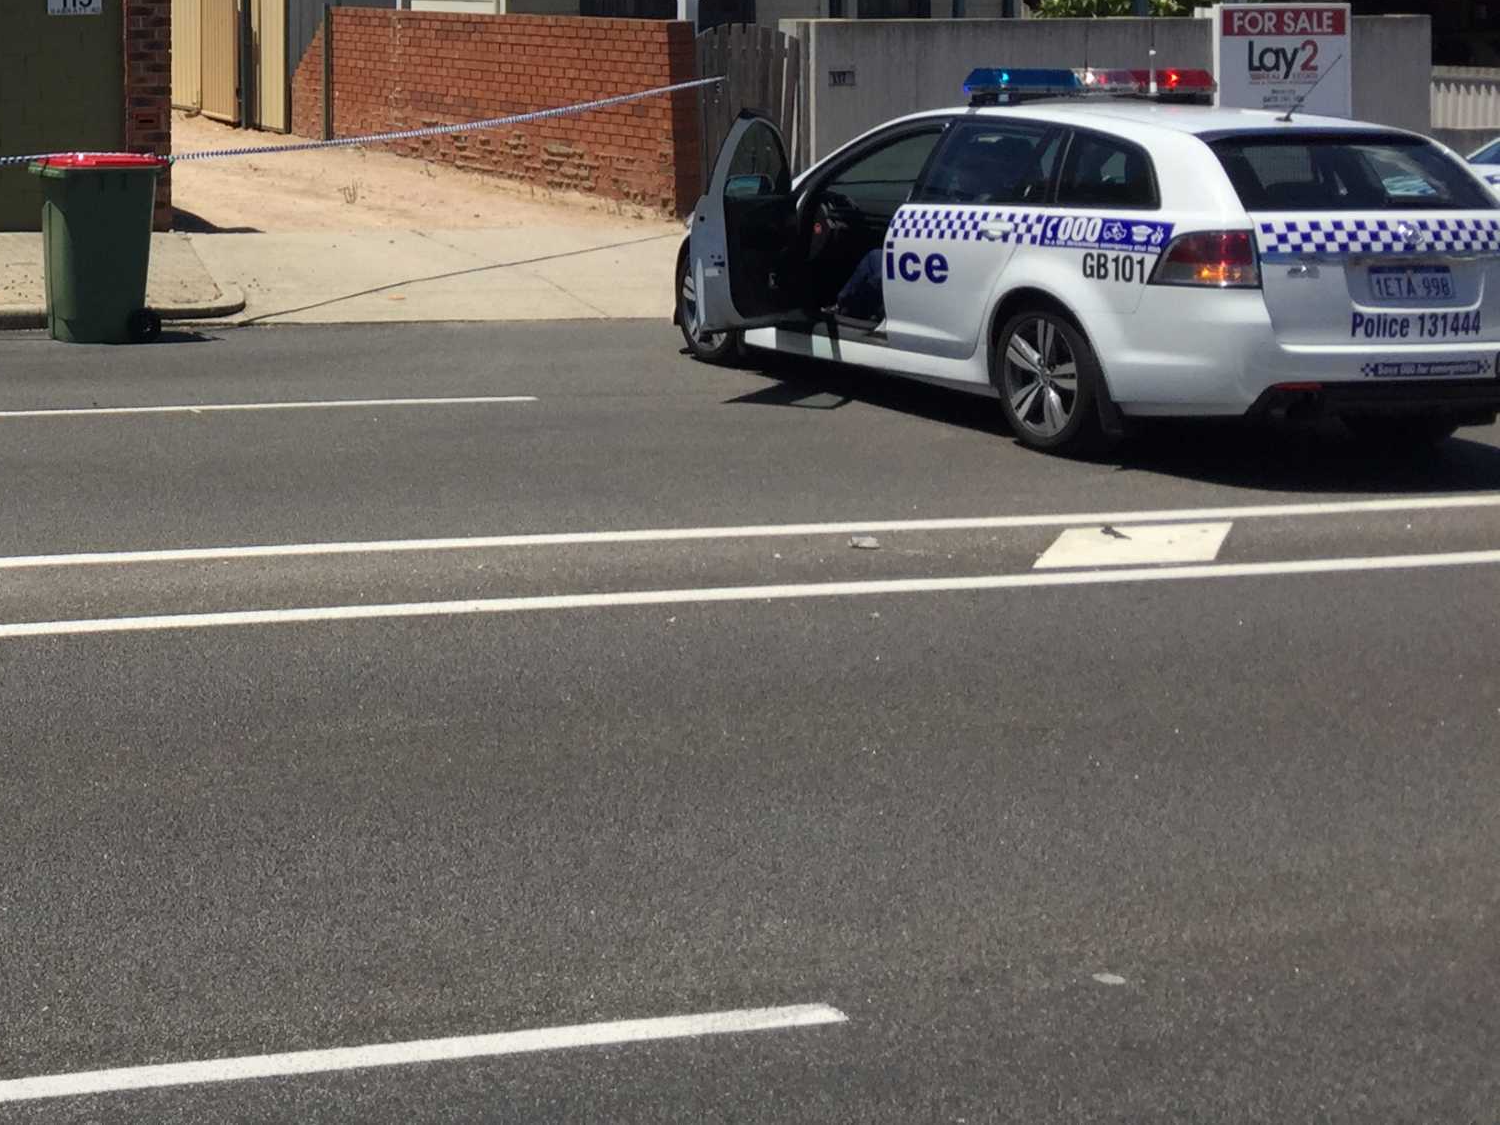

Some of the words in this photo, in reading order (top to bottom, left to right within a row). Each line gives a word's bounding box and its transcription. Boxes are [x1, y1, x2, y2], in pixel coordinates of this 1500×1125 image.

[1233, 12, 1277, 34] FOR
[1283, 11, 1333, 33] SALE
[1248, 40, 1318, 79] Lay2
[1056, 216, 1103, 242] 000
[885, 242, 949, 284] ice
[1082, 252, 1147, 284] GB101
[1351, 311, 1410, 339] Police
[1417, 310, 1481, 338] 131444
